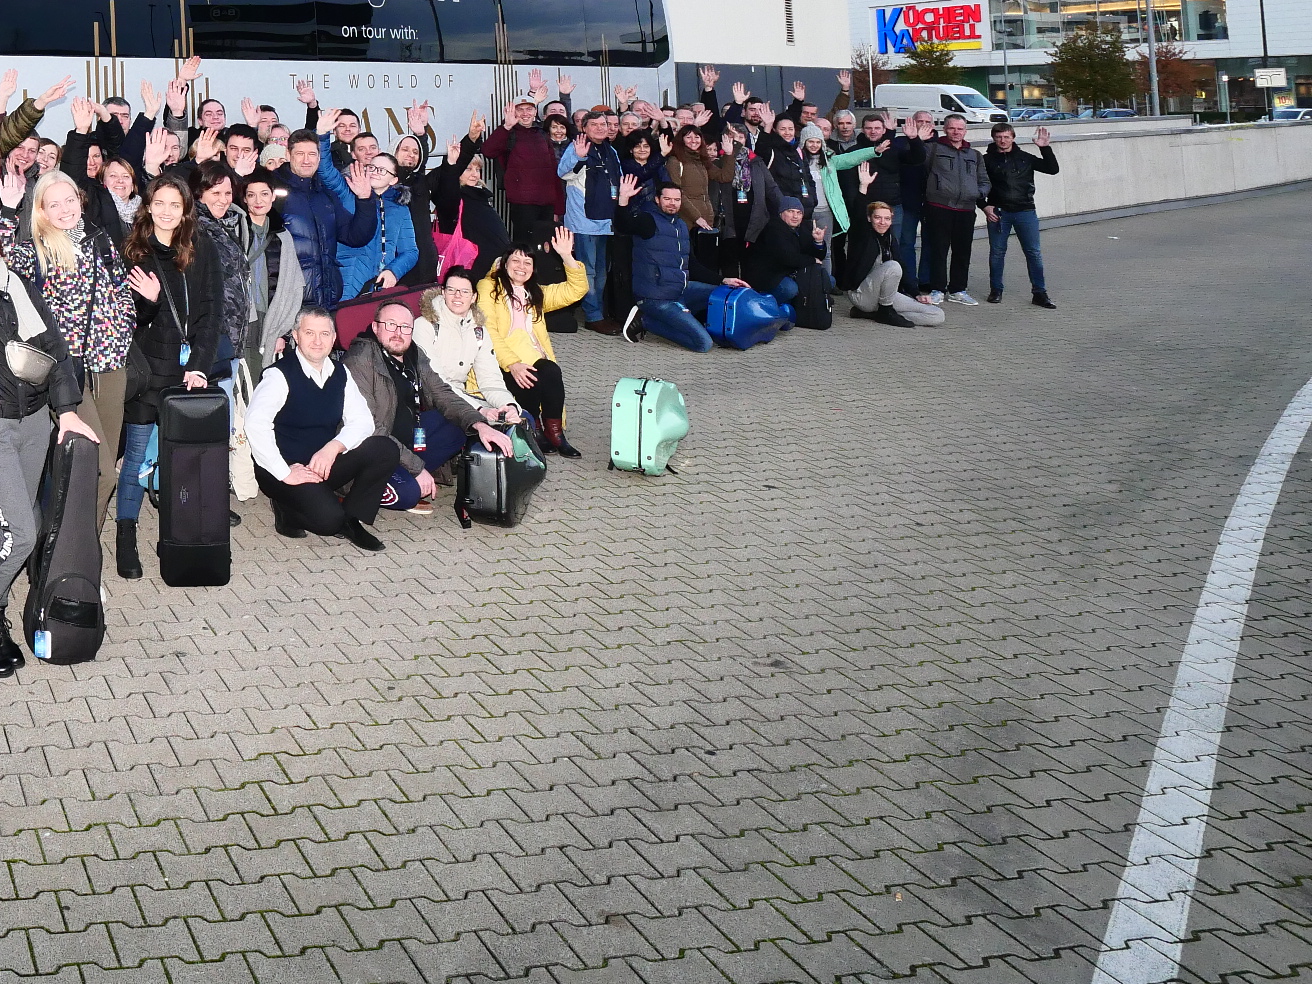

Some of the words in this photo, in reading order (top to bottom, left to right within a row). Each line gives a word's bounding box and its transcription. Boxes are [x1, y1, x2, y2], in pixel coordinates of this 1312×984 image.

[341, 26, 358, 38] on
[361, 25, 387, 39] tour
[389, 24, 419, 40] with:
[289, 74, 330, 90] THE
[348, 74, 418, 89] WORLD
[434, 74, 454, 89] OF
